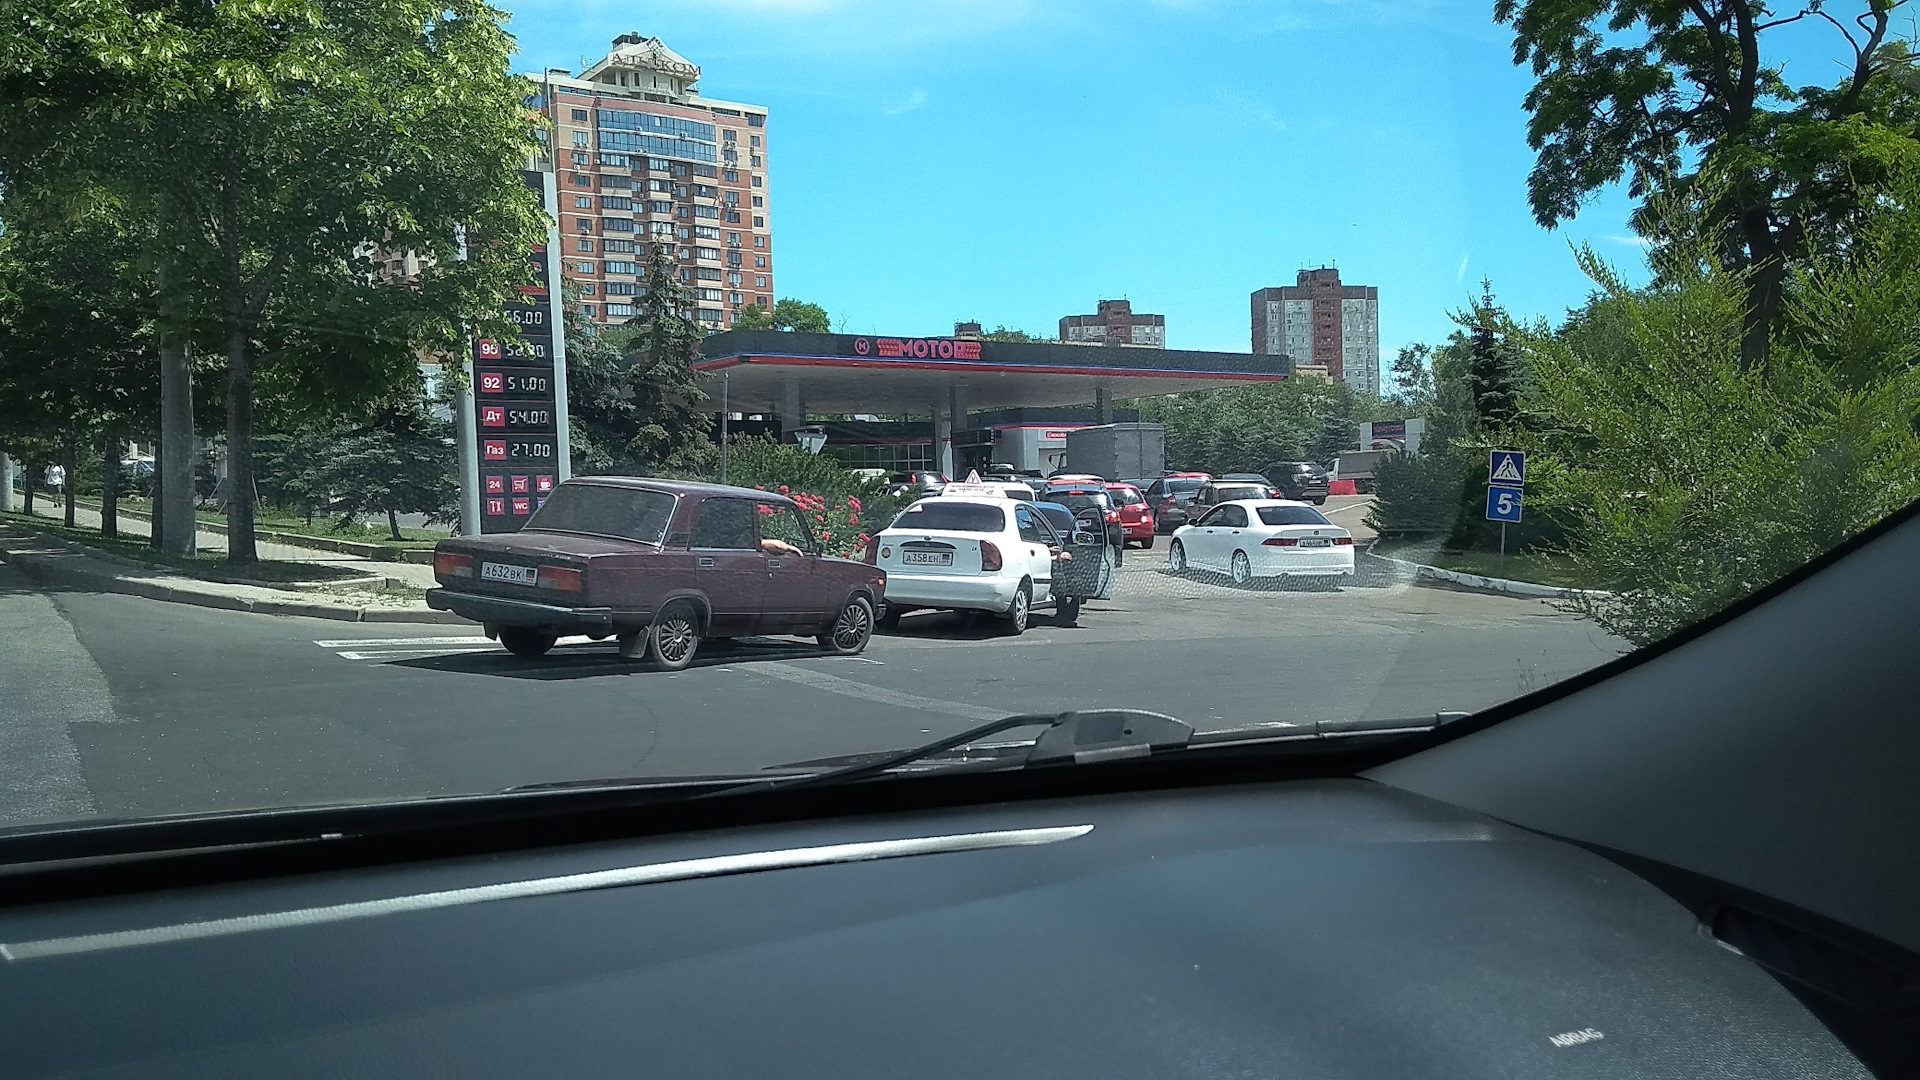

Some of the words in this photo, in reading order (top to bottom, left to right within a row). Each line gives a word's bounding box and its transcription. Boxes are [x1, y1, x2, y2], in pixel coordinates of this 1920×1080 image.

[481, 343, 499, 355] 95
[898, 339, 967, 359] MOTOR
[483, 377, 500, 389] 92
[507, 376, 547, 391] 51.00
[486, 411, 501, 422] Дт
[509, 410, 549, 424] 54.00
[486, 445, 504, 455] Газ
[511, 443, 551, 457] 27.00
[489, 480, 501, 489] 24
[514, 502, 529, 510] WC
[1497, 493, 1512, 515] 5
[484, 565, 523, 580] А632ВК
[1548, 1027, 1604, 1047] AIRBAG
